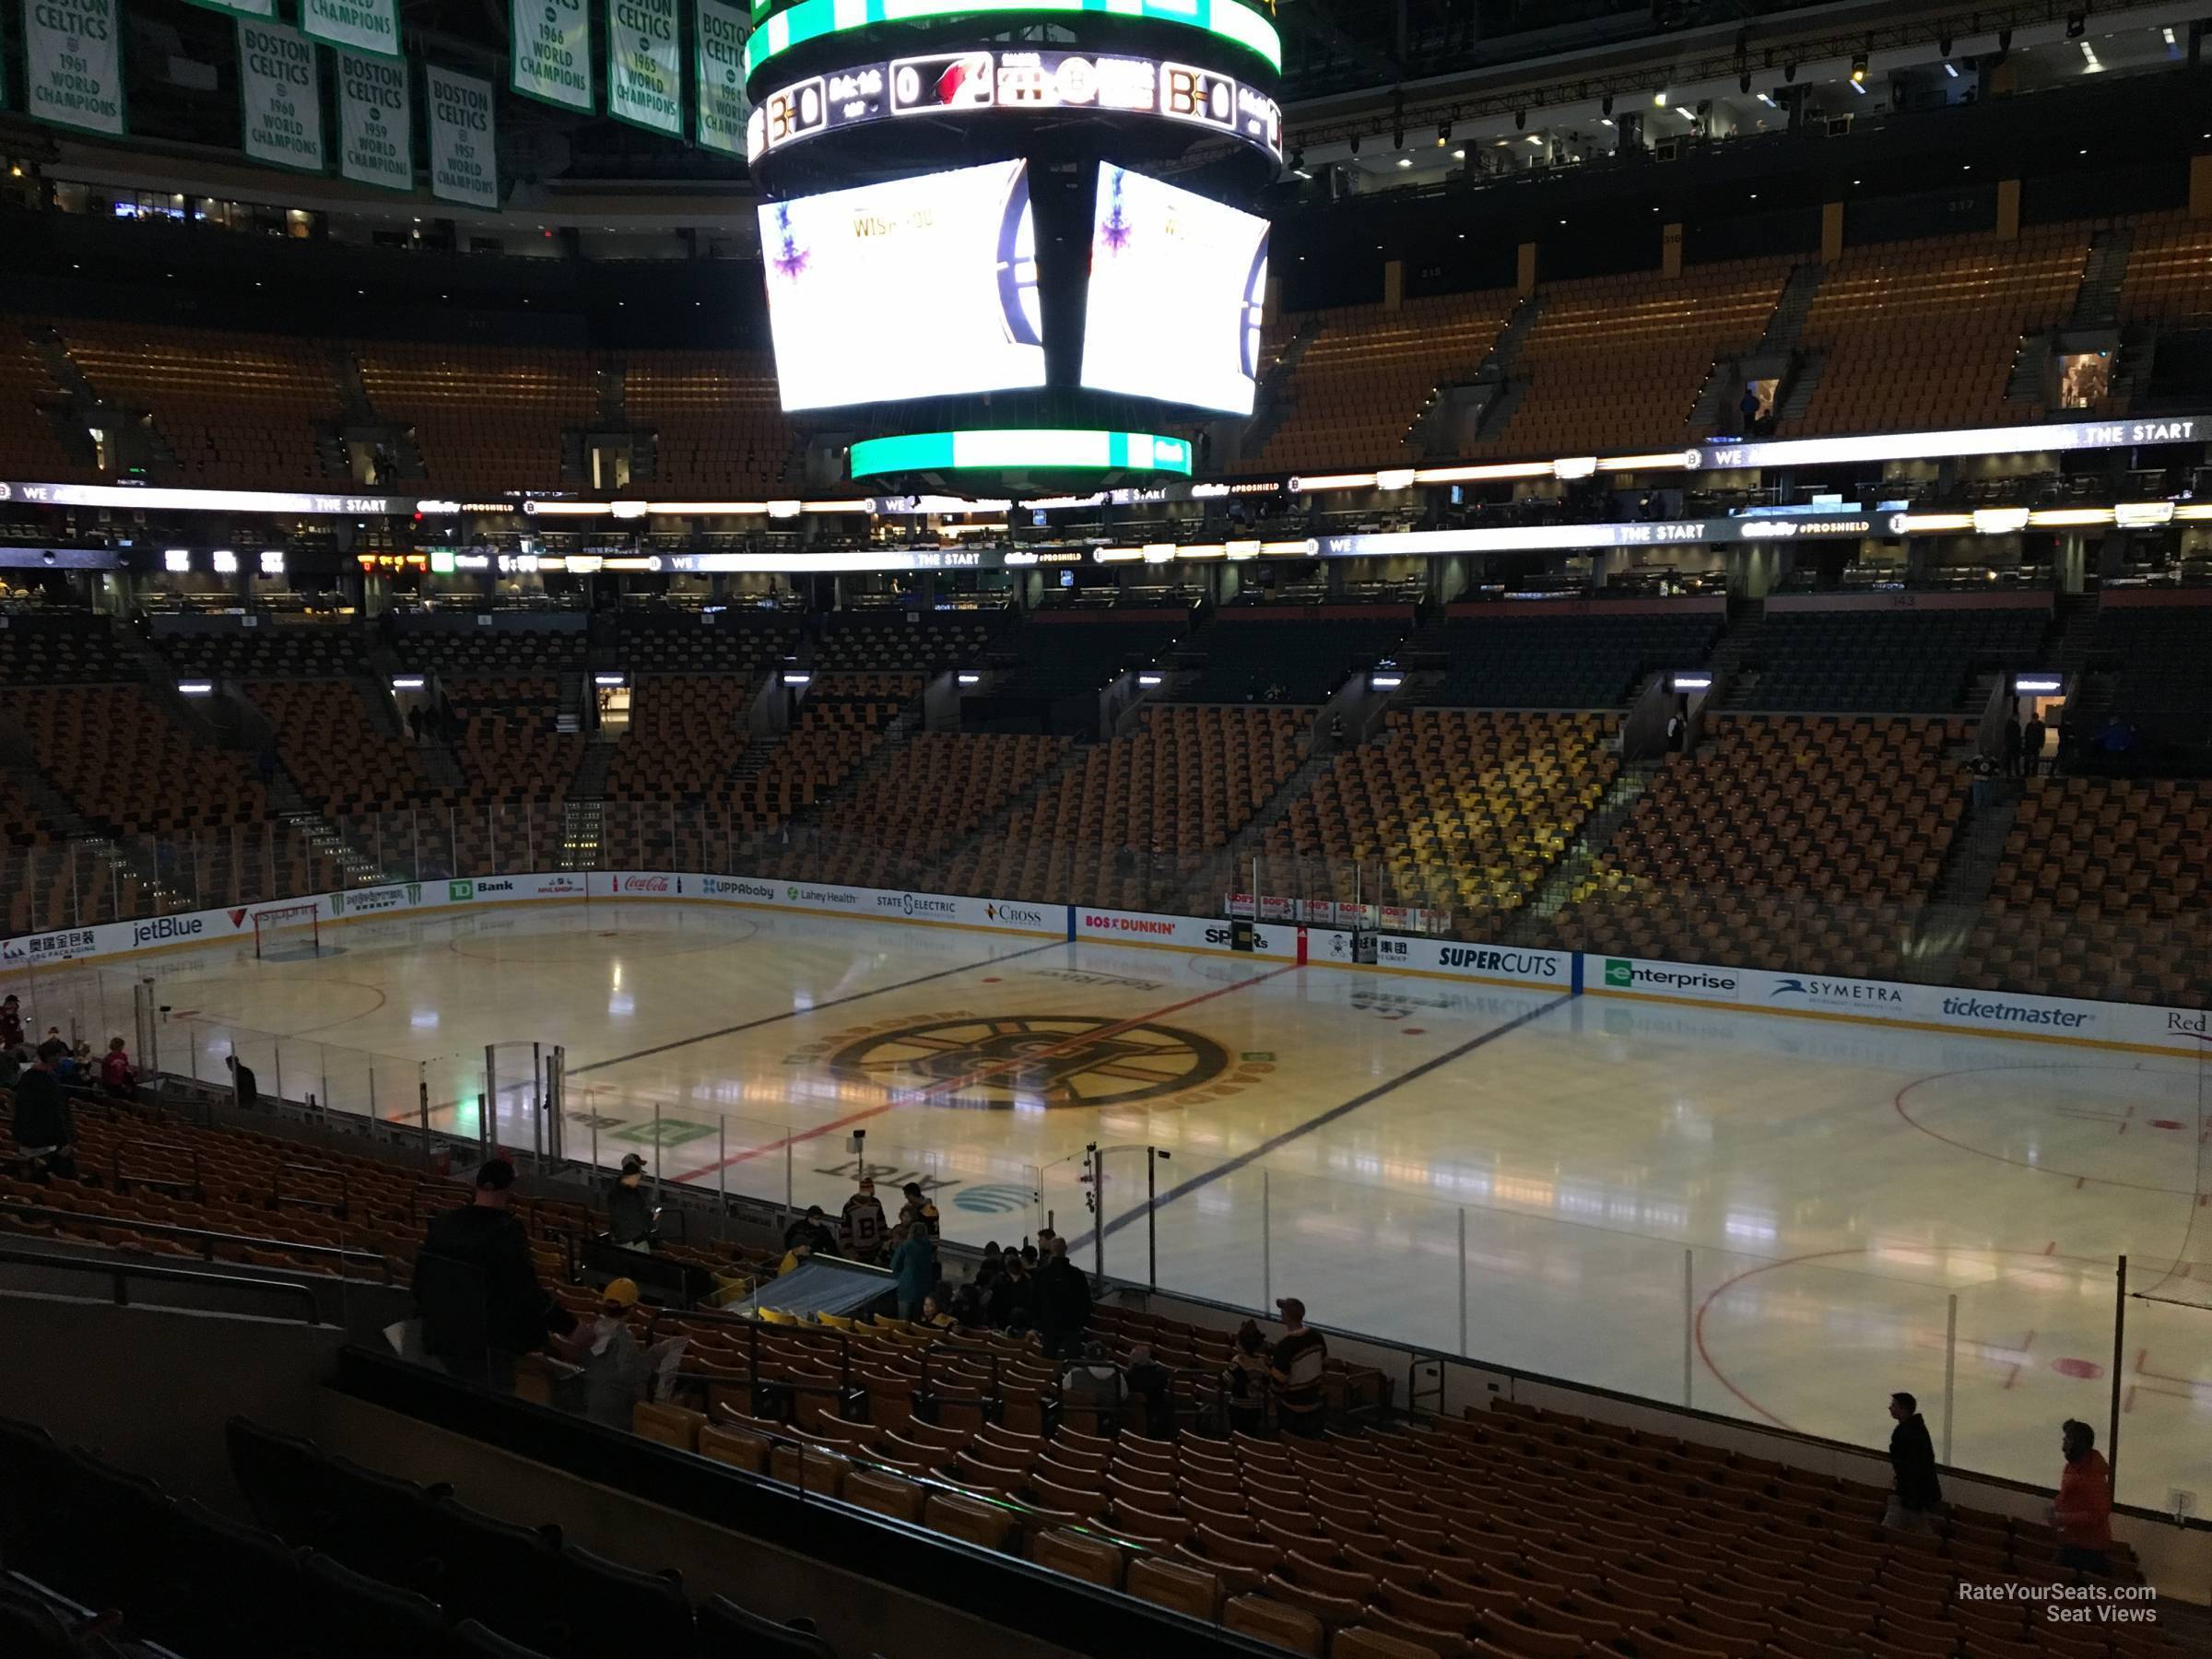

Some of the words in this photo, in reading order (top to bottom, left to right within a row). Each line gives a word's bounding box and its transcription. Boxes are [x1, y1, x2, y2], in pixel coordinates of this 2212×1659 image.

[36, 4, 108, 41] CELTICS
[311, 1, 392, 34] CHAMPIONS
[618, 4, 671, 41] CELTICS
[539, 23, 564, 45] 1966
[244, 29, 311, 64] BOSTON
[533, 40, 573, 67] WORLD
[706, 40, 746, 69] CELTIC
[60, 53, 88, 74] 1961
[250, 53, 309, 86] CELTICS
[343, 56, 403, 88] BOSTON
[521, 56, 586, 90] CHAMPIONS
[633, 52, 656, 73] 1965
[52, 71, 100, 95] WORLD
[628, 69, 664, 94] WORLD
[897, 66, 920, 103] 0
[36, 85, 117, 117] CHAMPIONS
[347, 80, 401, 109] CELTICS
[432, 79, 488, 112] BOSTON
[617, 85, 676, 116] CHAMPIONS
[1212, 82, 1230, 118] 0
[437, 102, 488, 132] CELTICS
[801, 88, 818, 124] 0
[263, 113, 303, 135] WORLD
[365, 122, 387, 138] 1959
[705, 115, 747, 136] CHAMPIO
[252, 128, 317, 156] CHAMPIONS
[359, 137, 396, 157] WORLD
[455, 143, 475, 159] 1957
[347, 150, 407, 176] CHAMPIONS
[447, 158, 482, 176] WORLD
[437, 171, 493, 194] CHAMPIONS
[2086, 426, 2123, 443] THE
[2133, 422, 2194, 441] START
[1716, 451, 1742, 465] WE
[24, 488, 47, 500] WE
[1232, 483, 1279, 493] #PROSHIELD
[316, 499, 340, 511] THE
[347, 500, 386, 512] START
[886, 500, 904, 511] WE
[1621, 526, 1651, 541] THE
[1656, 524, 1705, 540] START
[1800, 521, 1869, 534] #PROSHIELD
[1330, 540, 1351, 552] WE
[672, 557, 693, 569] WE
[920, 554, 941, 566] THE
[945, 553, 980, 565] START
[1893, 594, 1914, 607] 143
[477, 880, 513, 892] Bank
[716, 880, 774, 900] UPPAbaby
[800, 889, 826, 904] Lahey
[827, 891, 856, 905] Health
[877, 896, 902, 907] STATE
[914, 900, 956, 912] ELECTRIC
[999, 905, 1041, 923] CROSS
[133, 917, 203, 947] jetBlue
[1086, 915, 1110, 928] BOS
[1121, 919, 1176, 935] DUNKIN'
[1439, 947, 1558, 977] SUPERCUTS
[1609, 964, 1736, 991] enterprise
[1810, 981, 1902, 1003] SYMETRA
[1942, 997, 2088, 1029] ticketmaster
[2168, 1012, 2206, 1032] Red
[859, 1218, 875, 1240] B
